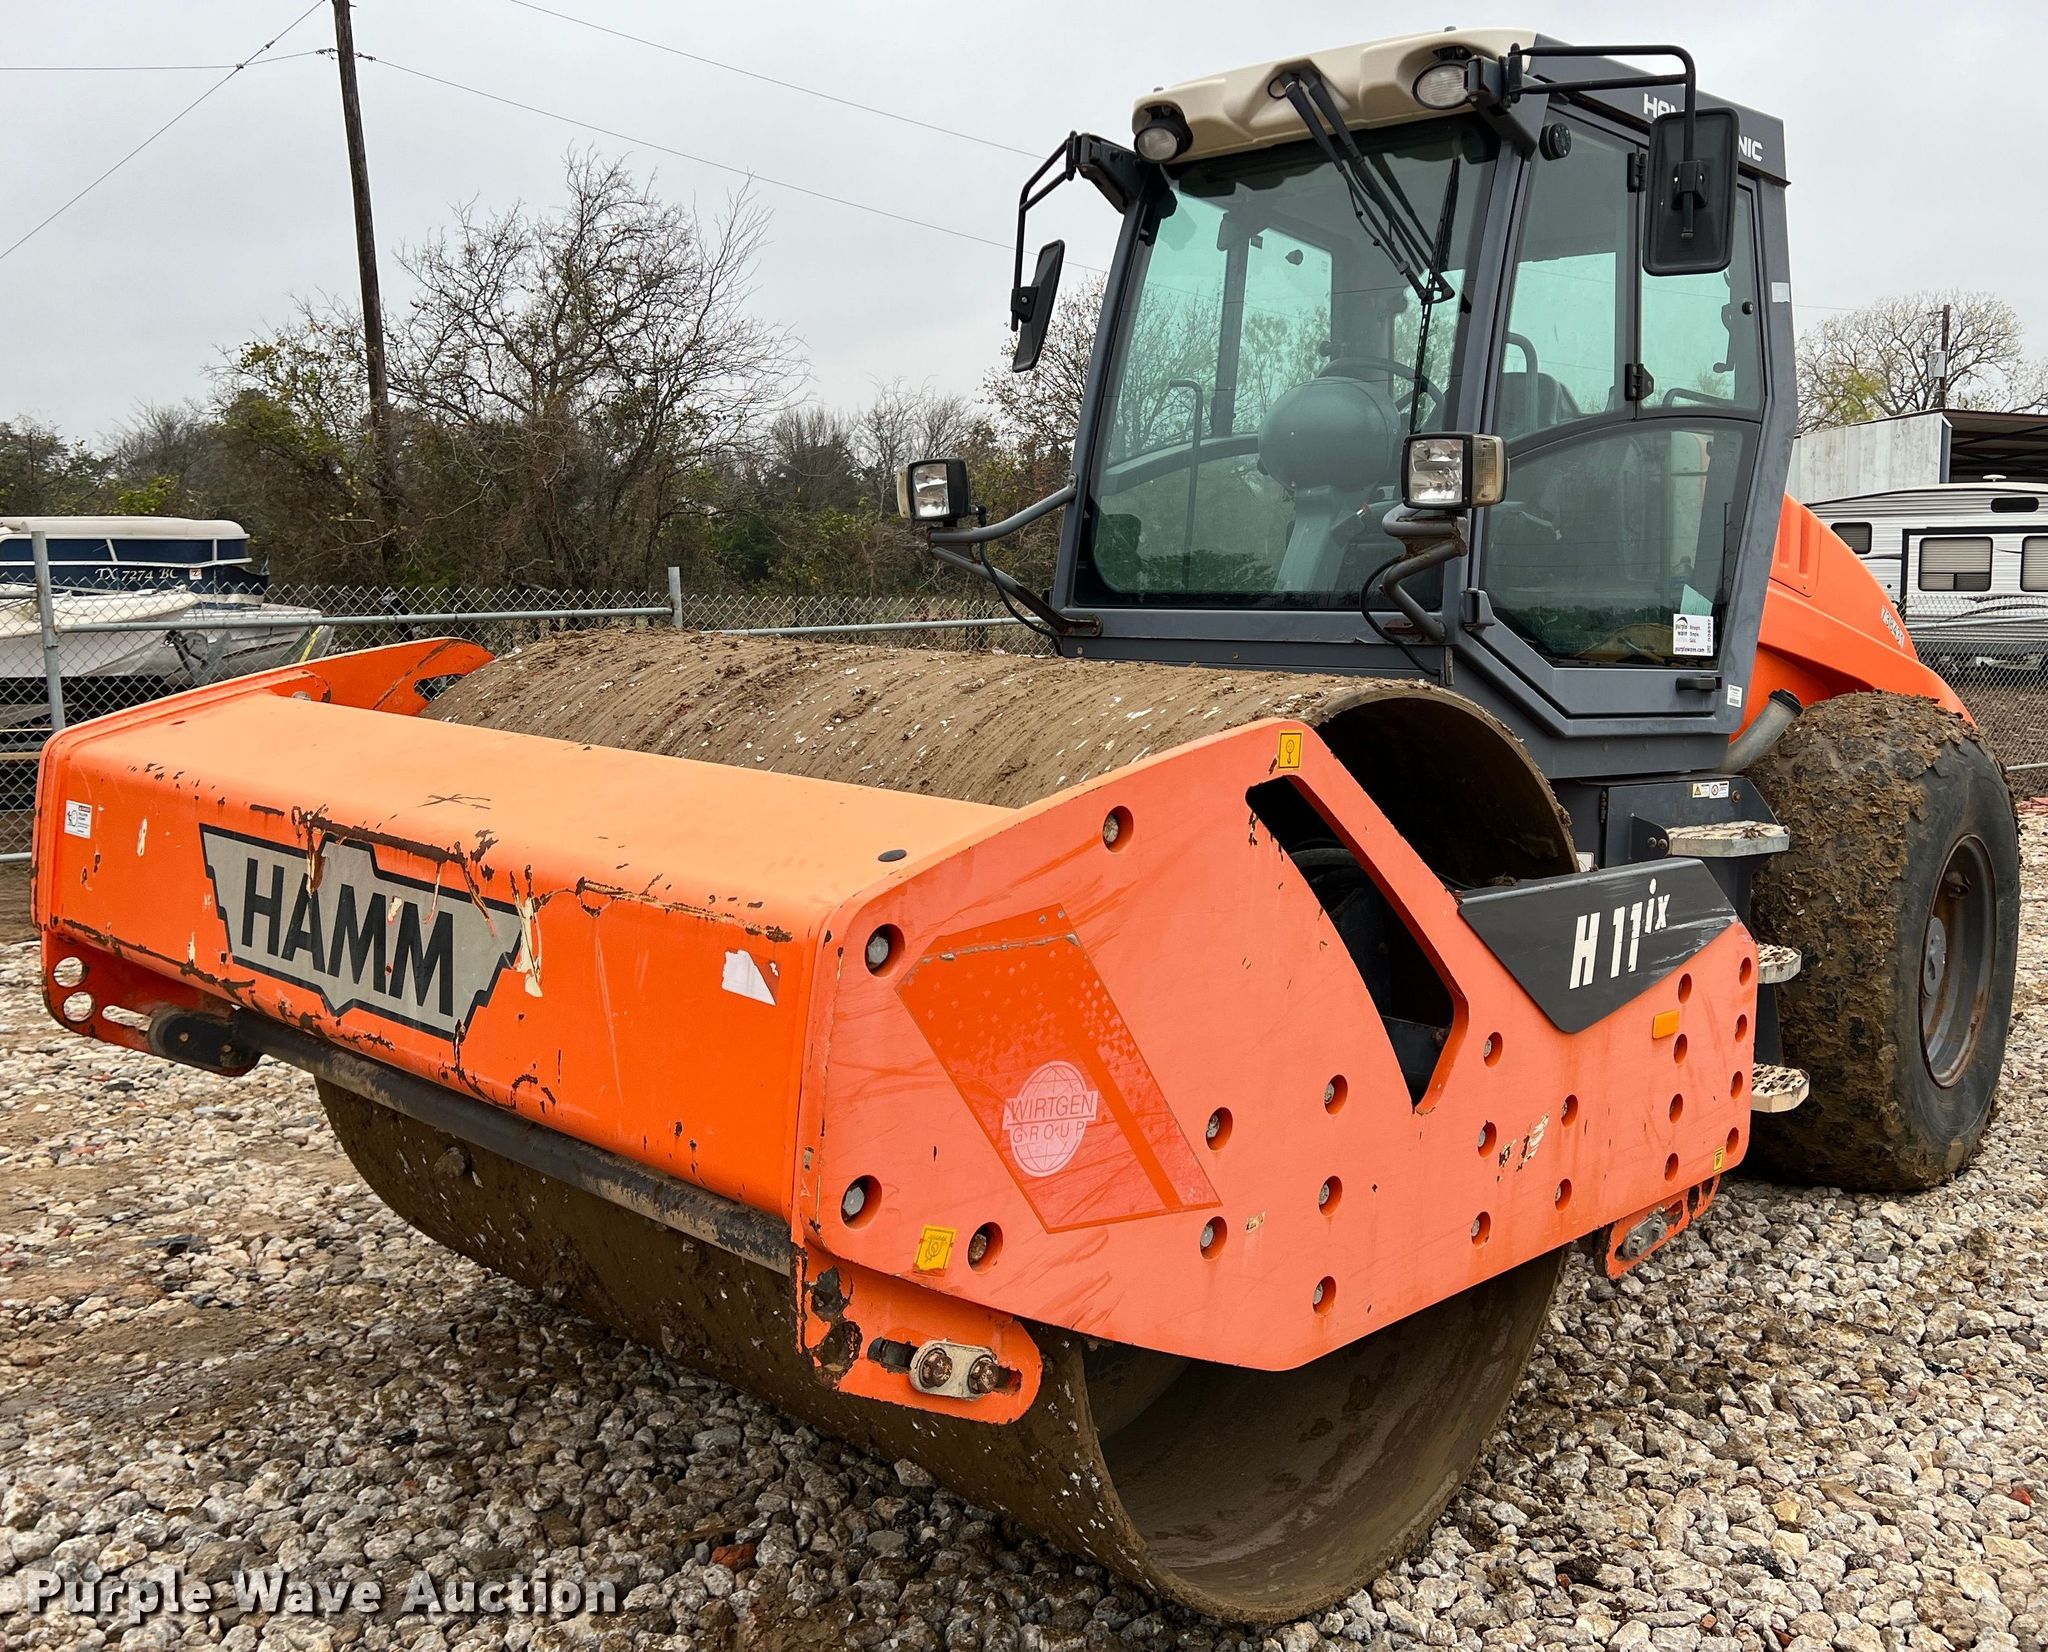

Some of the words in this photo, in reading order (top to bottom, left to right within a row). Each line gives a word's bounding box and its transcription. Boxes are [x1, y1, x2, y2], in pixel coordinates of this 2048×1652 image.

[95, 567, 118, 580] TX
[121, 570, 154, 581] 7274
[159, 568, 179, 579] BC
[242, 856, 455, 1018] HAMM
[1010, 1093, 1095, 1121] WIRTGEN
[1012, 1120, 1085, 1144] GROUP
